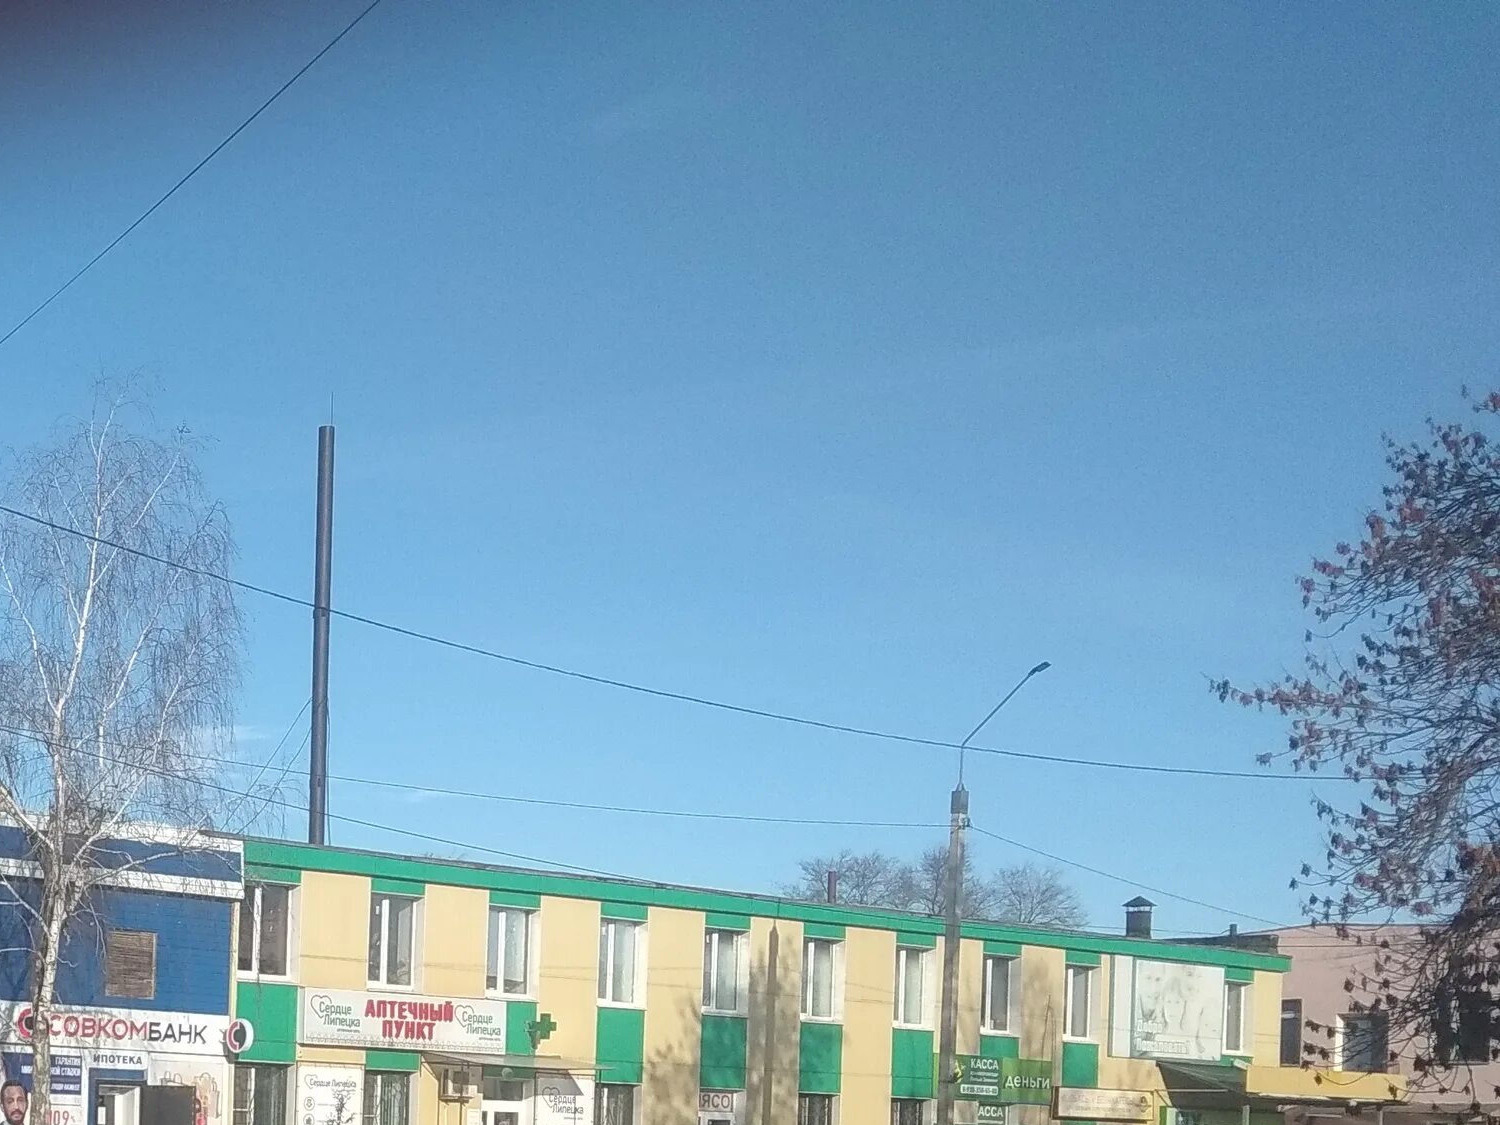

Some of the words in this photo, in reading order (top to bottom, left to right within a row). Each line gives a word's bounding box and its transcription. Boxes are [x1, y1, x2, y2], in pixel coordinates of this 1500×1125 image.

[319, 1001, 352, 1016] Сердце
[364, 998, 454, 1022] АПТЕЧНЫЙ
[323, 1014, 361, 1028] Липецка
[462, 1010, 493, 1024] Сердце
[48, 1014, 208, 1044] СОВКОМБАНК
[381, 1020, 437, 1041] ПУНКТ
[466, 1023, 501, 1036] Липецка
[93, 1053, 143, 1065] ИПОТЕКА
[970, 1058, 999, 1070] КАССА
[700, 1093, 730, 1109] ЯСО
[978, 1106, 1004, 1117] АССА
